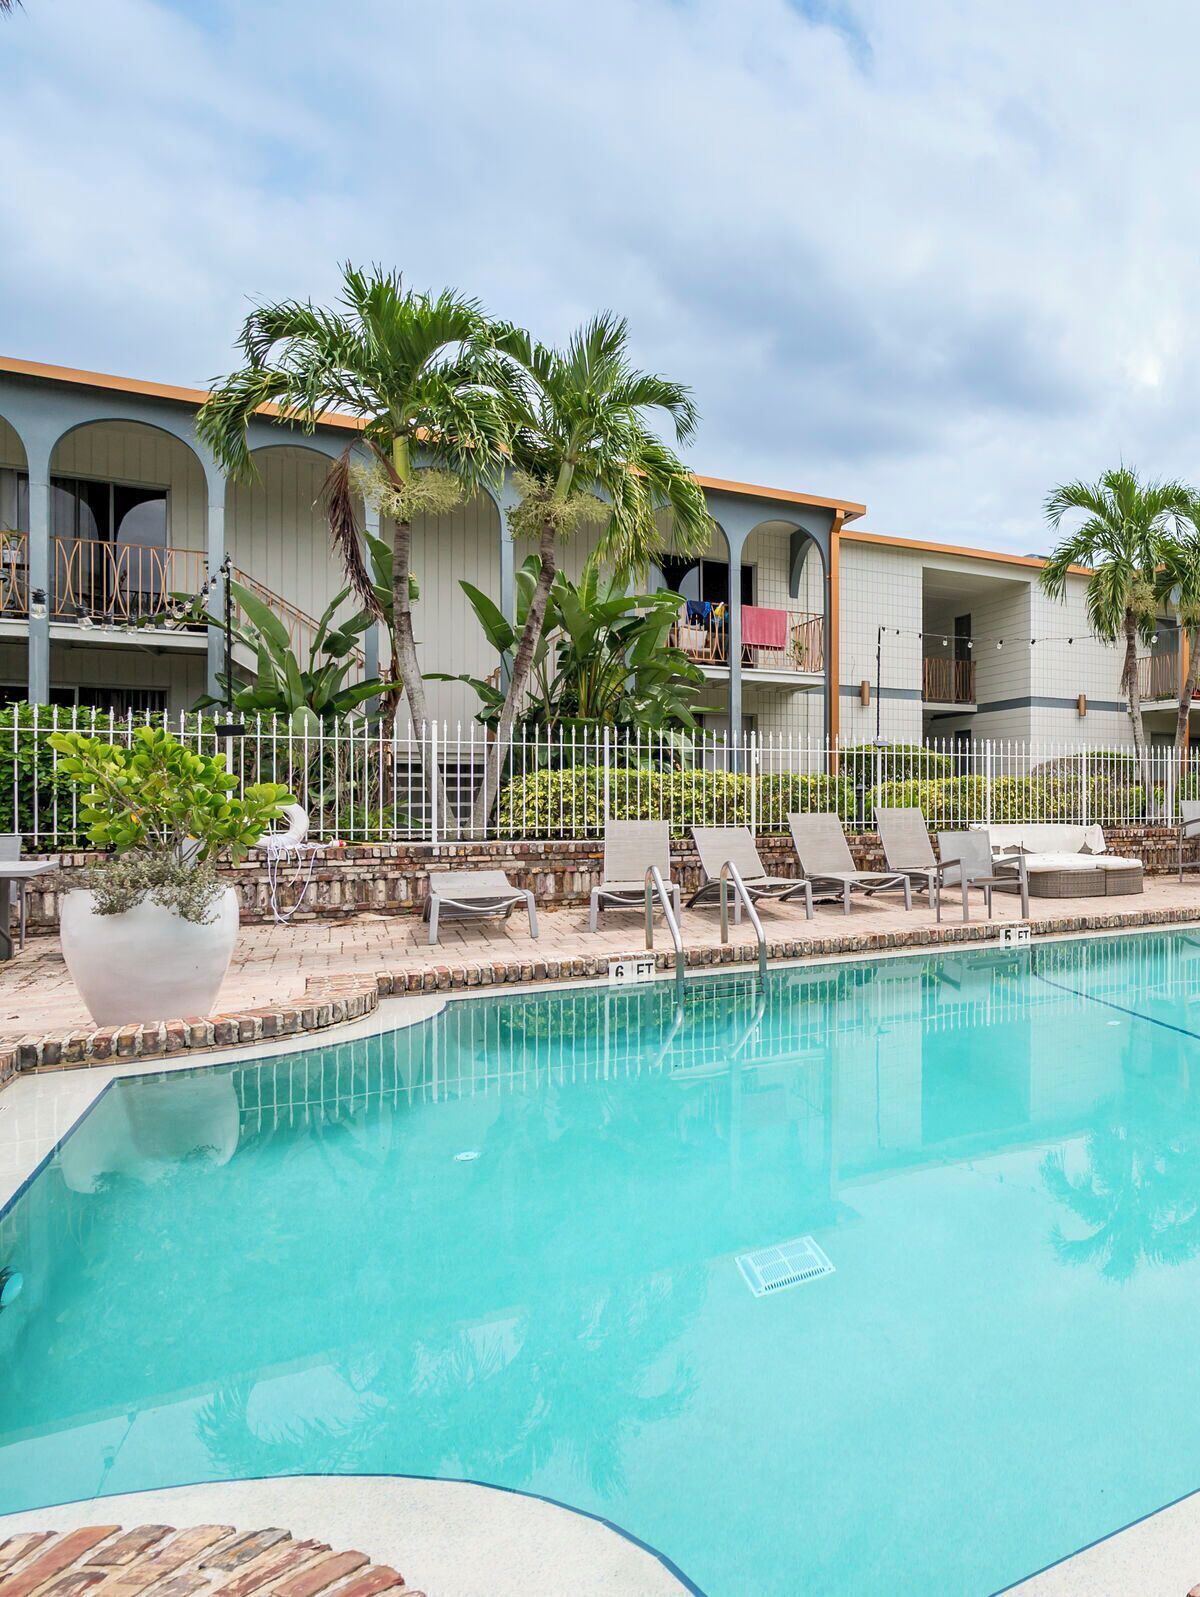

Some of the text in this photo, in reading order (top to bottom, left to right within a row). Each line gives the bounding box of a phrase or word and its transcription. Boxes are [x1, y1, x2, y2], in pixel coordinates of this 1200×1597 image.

[1018, 930, 1029, 940] FT
[615, 963, 654, 977] 6 FT
